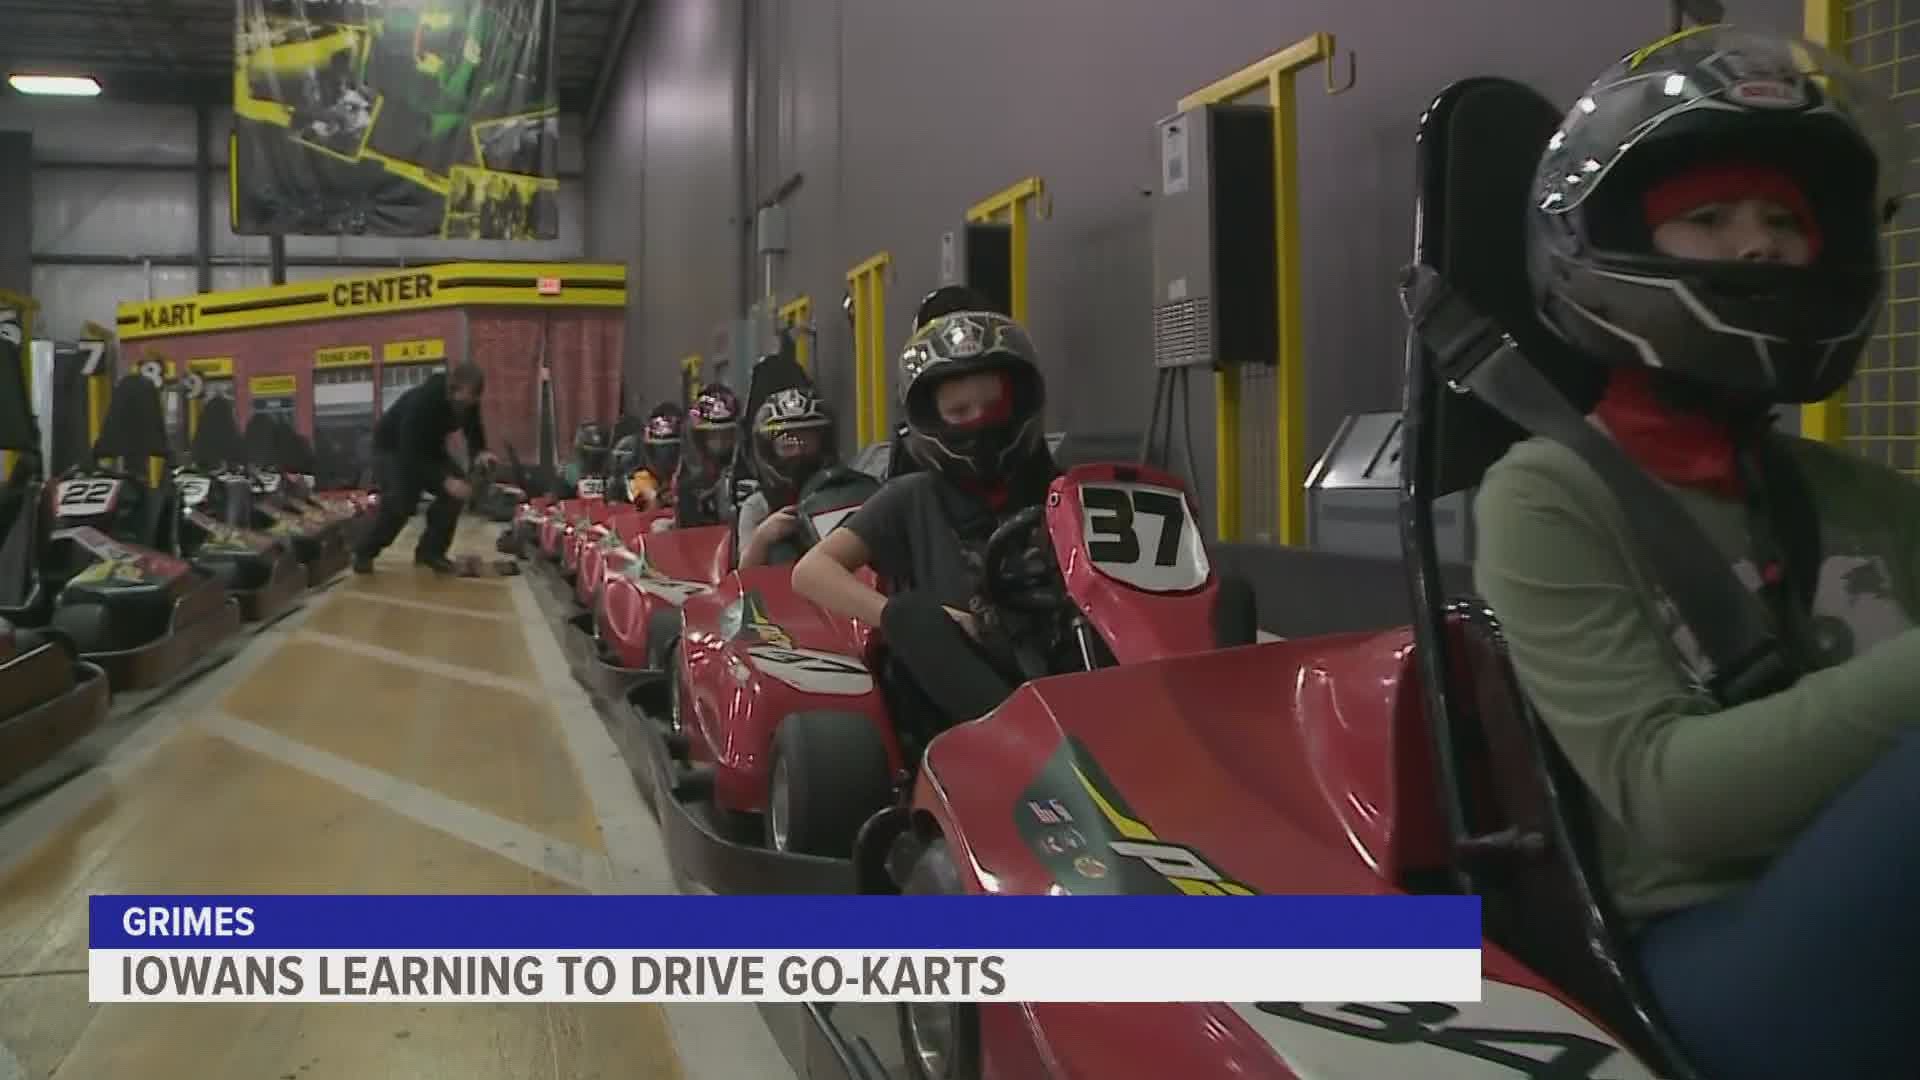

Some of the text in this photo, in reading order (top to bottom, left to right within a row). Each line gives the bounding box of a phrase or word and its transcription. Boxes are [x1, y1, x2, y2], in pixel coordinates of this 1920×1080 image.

[141, 273, 433, 329] KART CENTER
[79, 342, 105, 375] 7
[61, 482, 113, 504] 22
[1081, 487, 1185, 566] 37
